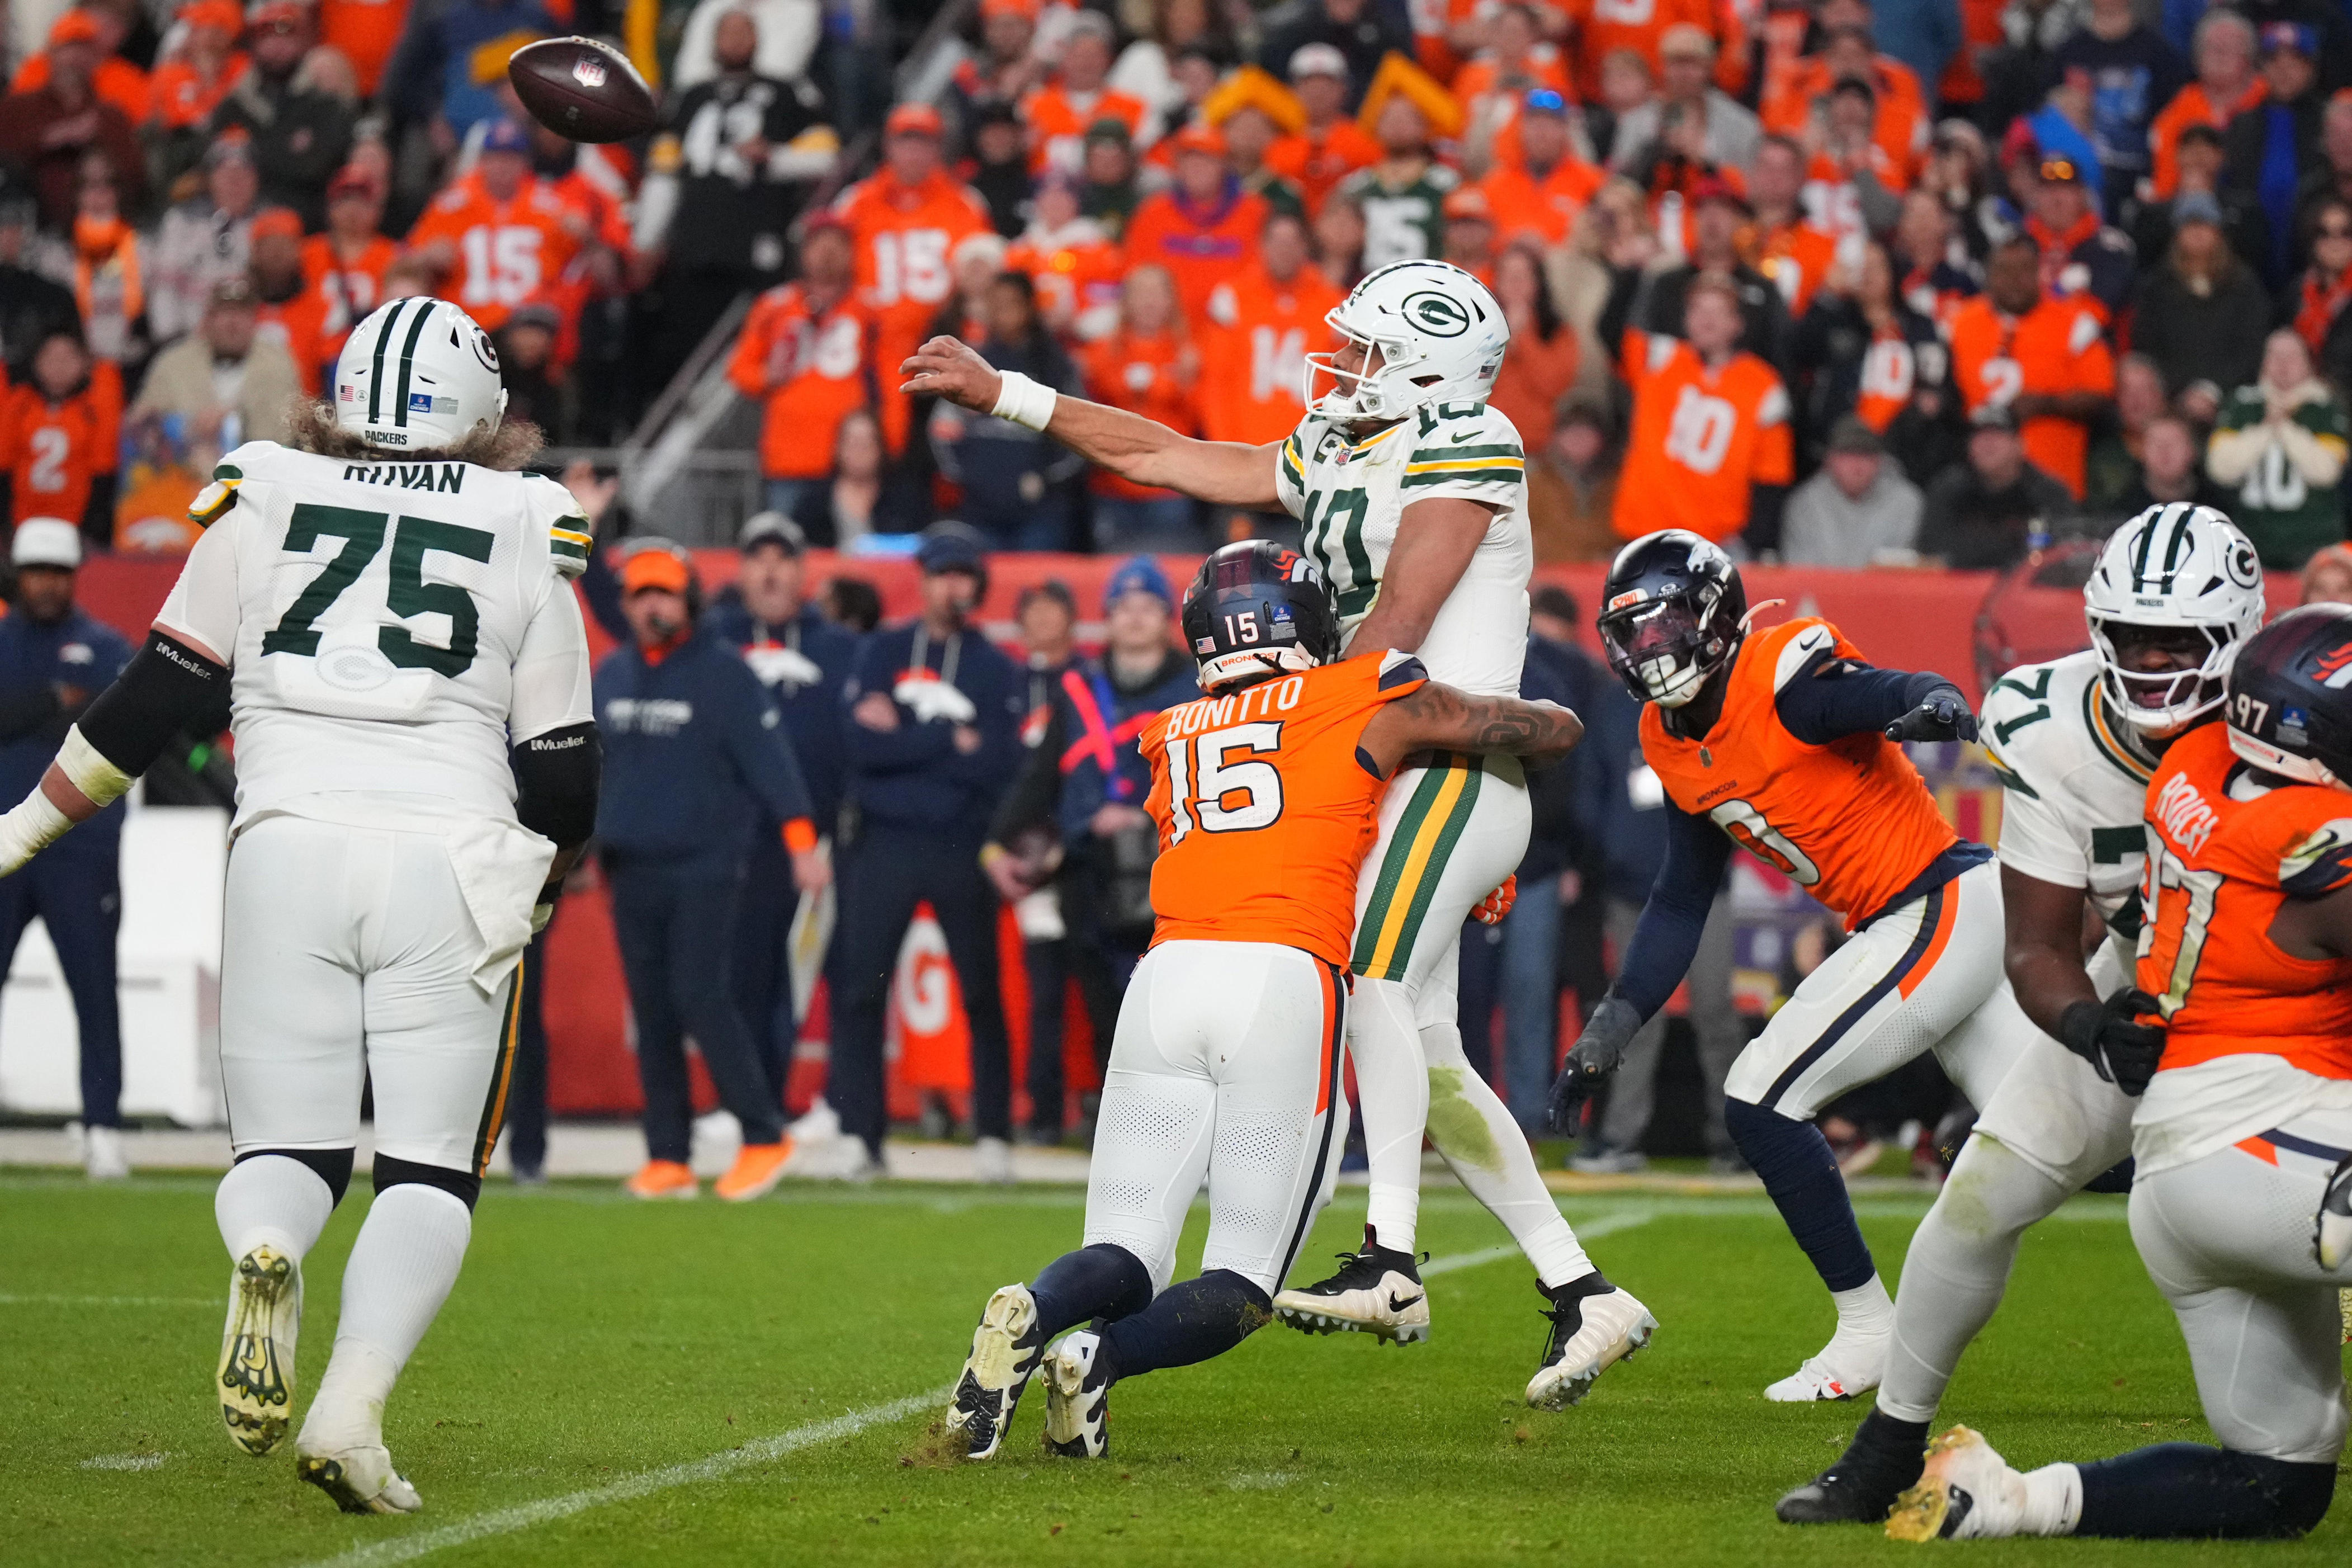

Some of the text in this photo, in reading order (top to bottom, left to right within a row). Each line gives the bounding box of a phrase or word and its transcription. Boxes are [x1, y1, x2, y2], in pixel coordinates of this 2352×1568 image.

[578, 62, 603, 81] NFL
[462, 228, 542, 306] 15
[867, 229, 953, 305] 15
[29, 426, 70, 493] 2
[365, 429, 408, 446] PACKERS
[1665, 385, 1736, 475] 10
[260, 502, 495, 679] 75
[1225, 611, 1259, 646] 15
[1164, 676, 1304, 742] BONITTO
[2237, 693, 2270, 735] 97
[1165, 720, 1286, 848] 15
